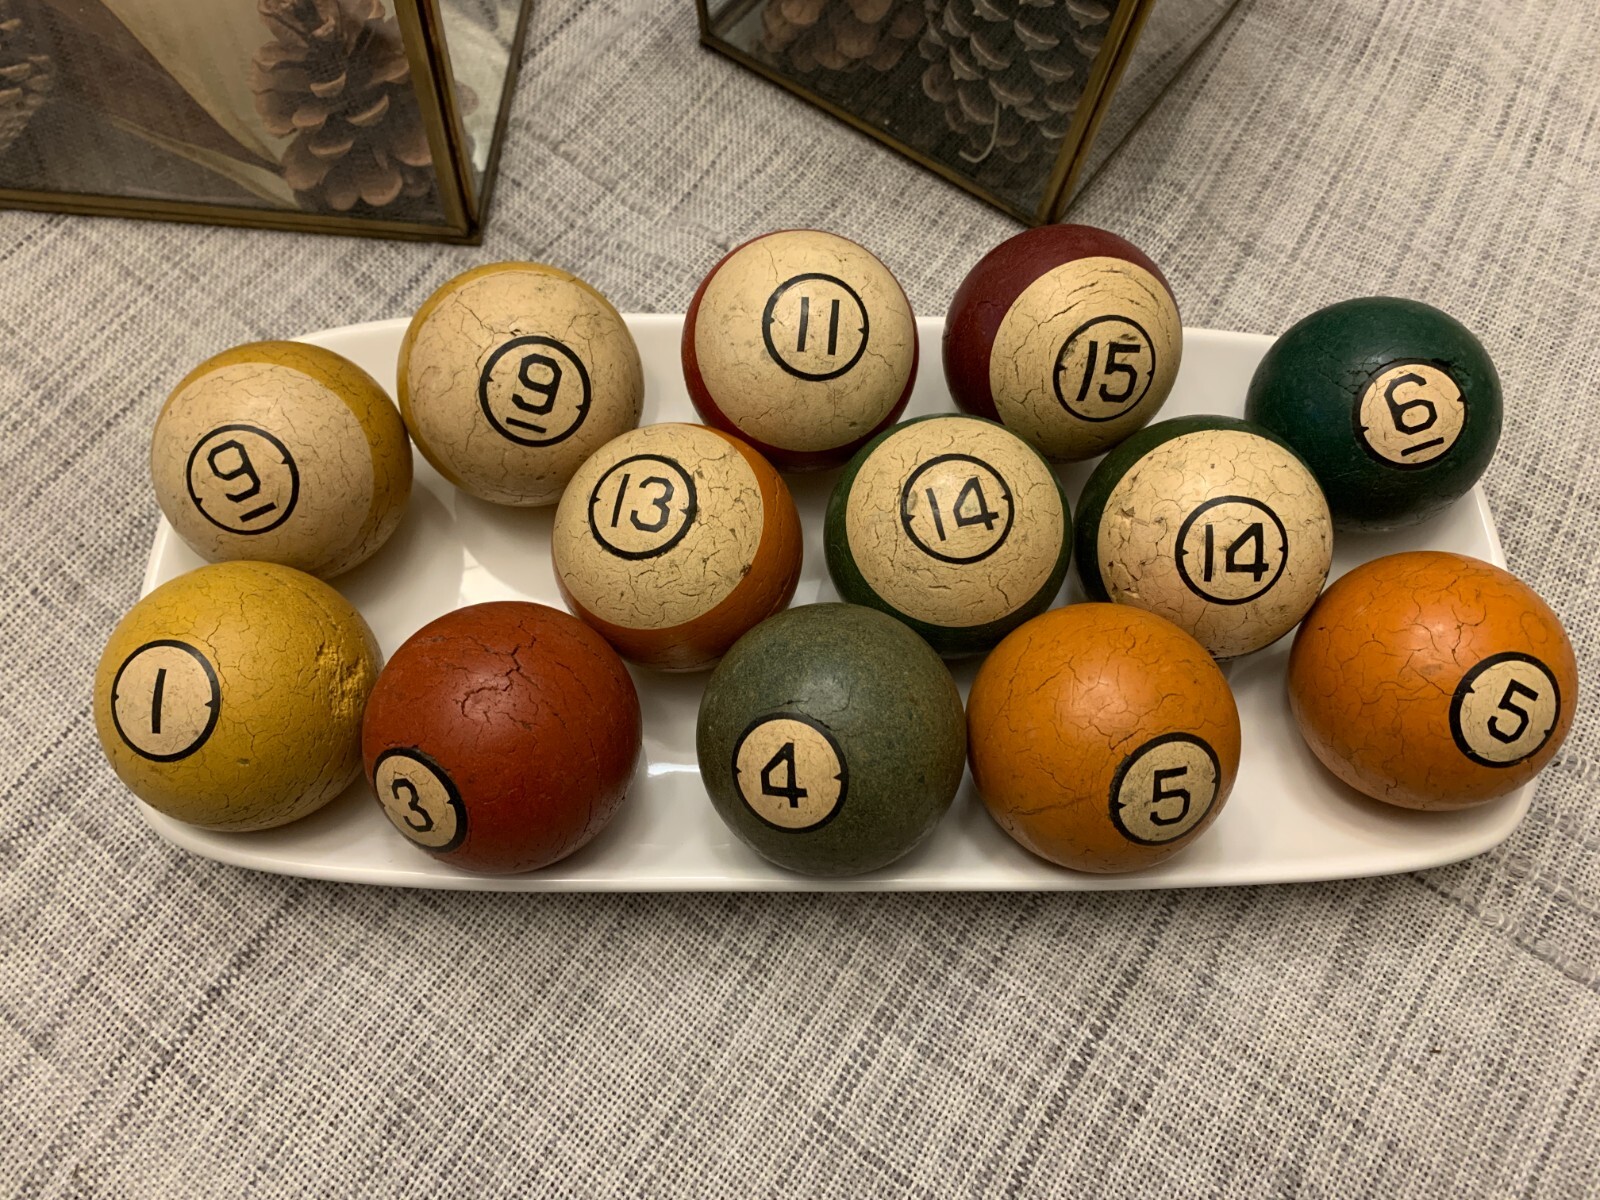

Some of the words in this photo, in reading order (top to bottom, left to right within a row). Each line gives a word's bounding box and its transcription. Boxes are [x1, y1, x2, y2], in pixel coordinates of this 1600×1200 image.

[796, 296, 841, 356] 11
[511, 353, 562, 415] 9
[1075, 339, 1141, 403] 15
[1383, 373, 1438, 435] 6
[207, 439, 261, 502] 9
[610, 473, 674, 533] 13
[925, 476, 1000, 542] 14
[1203, 522, 1270, 583] 14
[151, 668, 167, 735] 1
[1486, 678, 1540, 745] 5
[391, 777, 434, 834] 3
[760, 742, 808, 809] 4
[1150, 766, 1191, 827] 5
